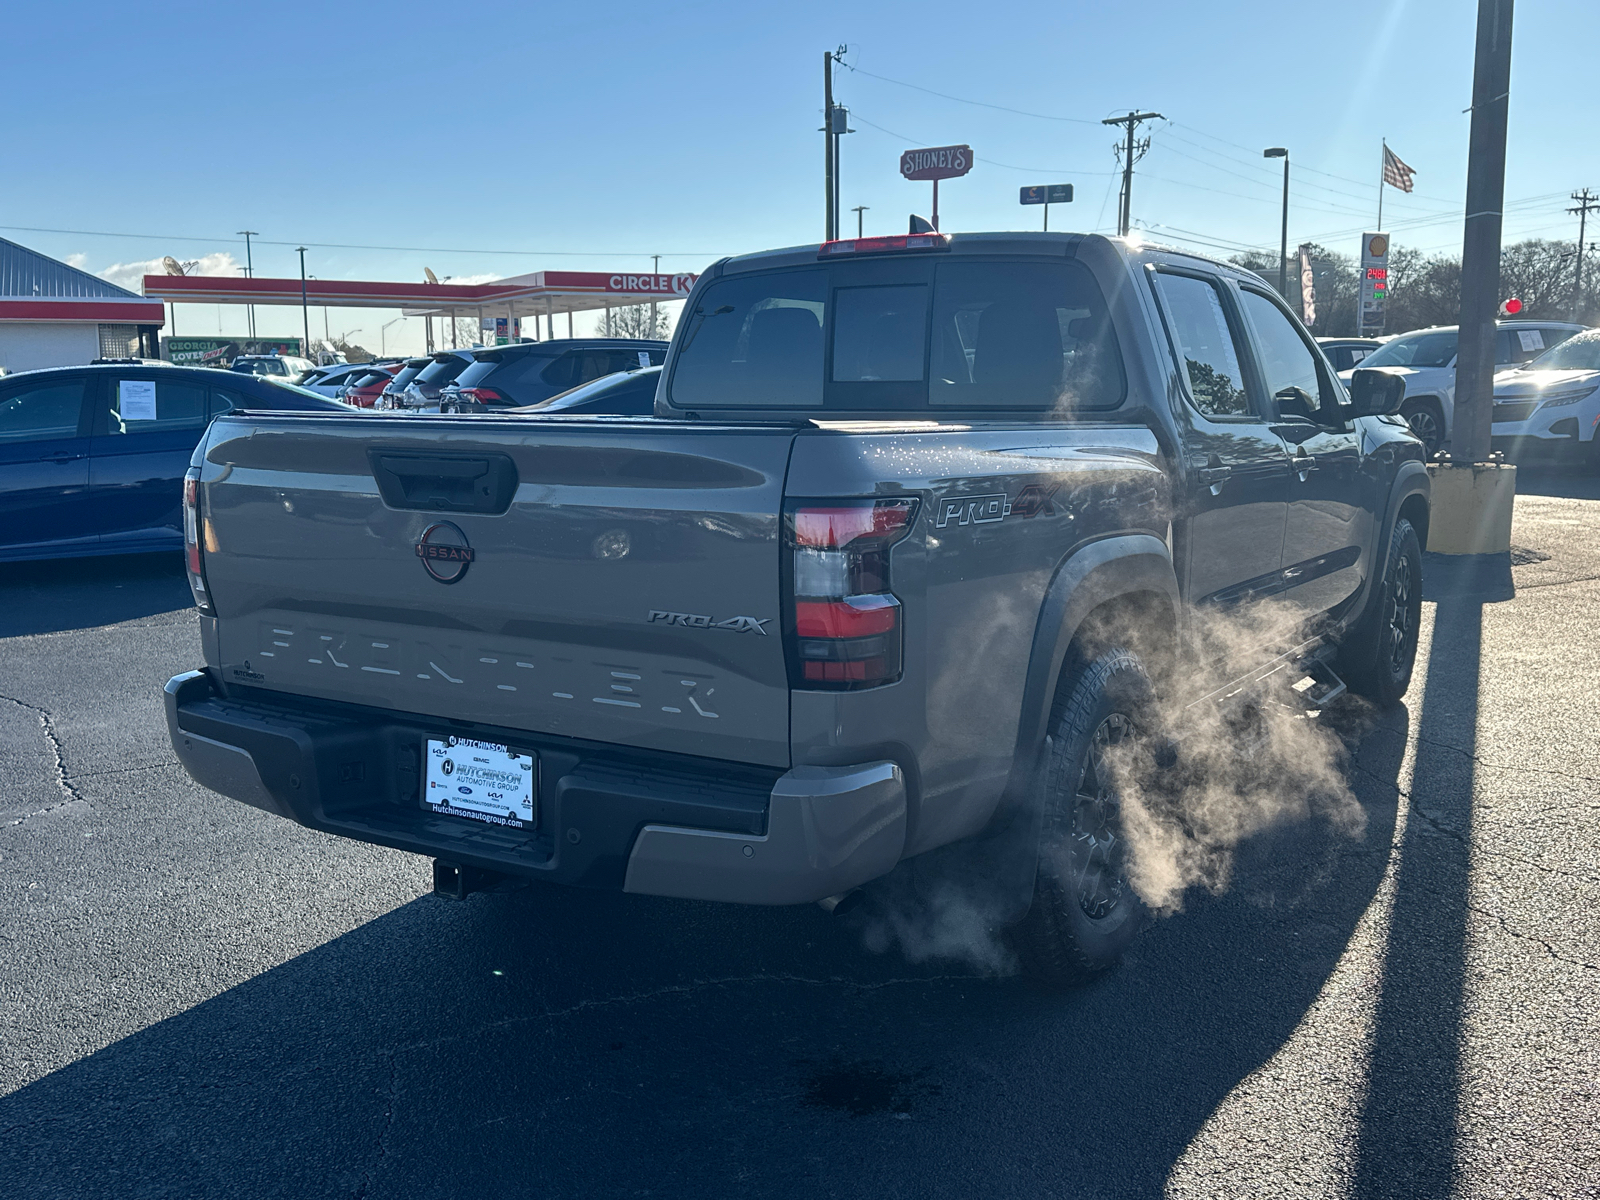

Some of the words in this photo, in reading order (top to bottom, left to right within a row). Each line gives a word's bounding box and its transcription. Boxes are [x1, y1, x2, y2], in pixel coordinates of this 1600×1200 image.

[903, 149, 965, 175] SHONEY'S
[609, 275, 668, 291] CIRCLE
[169, 341, 218, 351] GEORGIA
[171, 351, 204, 361] LOVES
[416, 545, 471, 560] NISSAN
[458, 737, 508, 753] HUTCHINSON
[473, 756, 490, 764] GMC
[456, 763, 523, 785] HUTCHINSON
[457, 775, 496, 789] AUTOMOTIVE
[497, 782, 519, 791] GROUP
[432, 804, 523, 828] Hutchinsonautogroup.com
